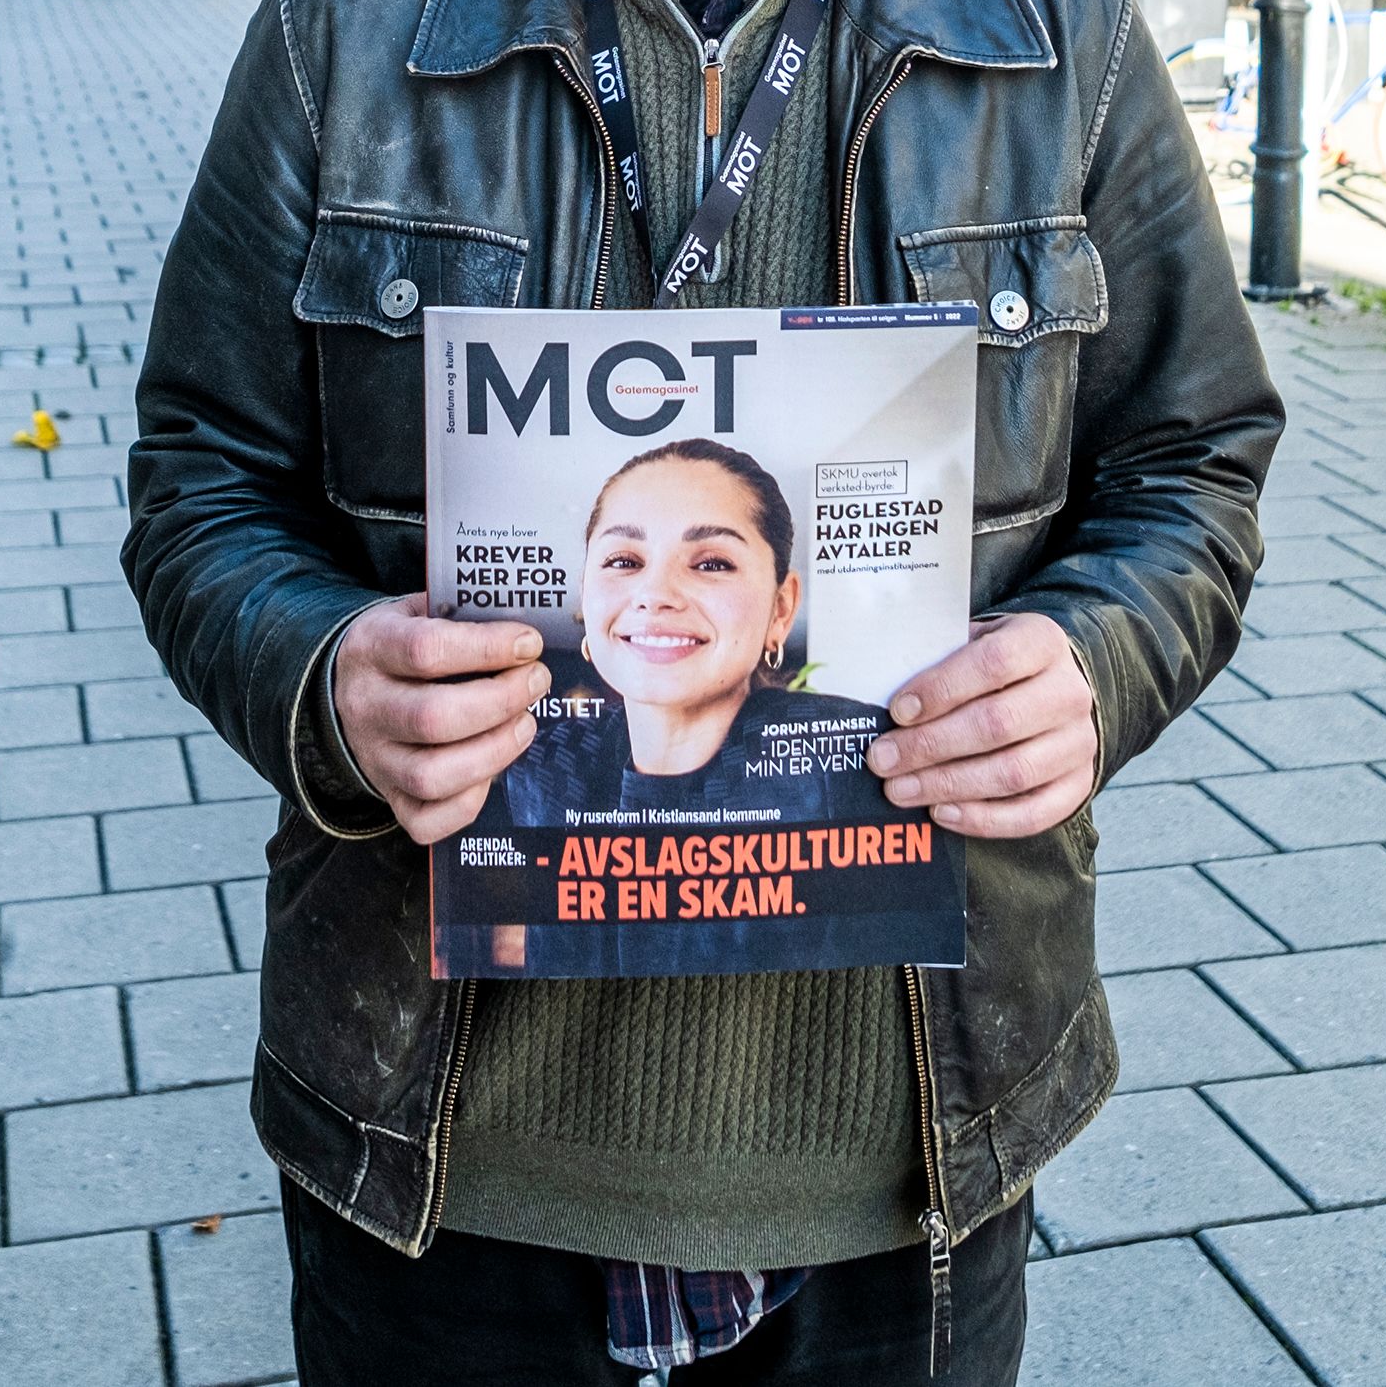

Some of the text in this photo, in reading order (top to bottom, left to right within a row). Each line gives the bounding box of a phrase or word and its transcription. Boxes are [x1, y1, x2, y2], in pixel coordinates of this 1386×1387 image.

[591, 49, 620, 104] MOT
[771, 37, 806, 96] MOT
[726, 135, 762, 196] MOT
[619, 155, 639, 212] MOT
[666, 236, 708, 293] MOT
[995, 295, 1016, 313] CHOICE
[445, 341, 456, 434] Samfunn og kultur
[615, 383, 700, 397] Gatemagasinet
[820, 465, 898, 481] SKMU overtok
[816, 499, 944, 521] FUGLESTAD
[456, 521, 538, 540] Årets nye lover
[816, 519, 939, 541] HAR INGEN
[456, 544, 554, 564] KREVER
[816, 540, 912, 561] AVTALER
[456, 567, 567, 586] MER FOR
[817, 561, 940, 575] med utdanningsinstitusjonene
[457, 589, 568, 608] POLITIET
[761, 716, 877, 737] JORUN STIANSEN
[745, 758, 783, 778] MIN
[789, 756, 813, 776] ER
[565, 808, 582, 827] Ny
[583, 809, 640, 824] rusreform
[648, 808, 721, 824] Kristiansand
[723, 807, 782, 823] kommune
[460, 837, 515, 852] ARENDAL
[558, 823, 932, 878] AVSLAGSKULTUREN
[460, 851, 526, 866] POLITIKER:
[558, 875, 807, 921] ER EN SKAM.
